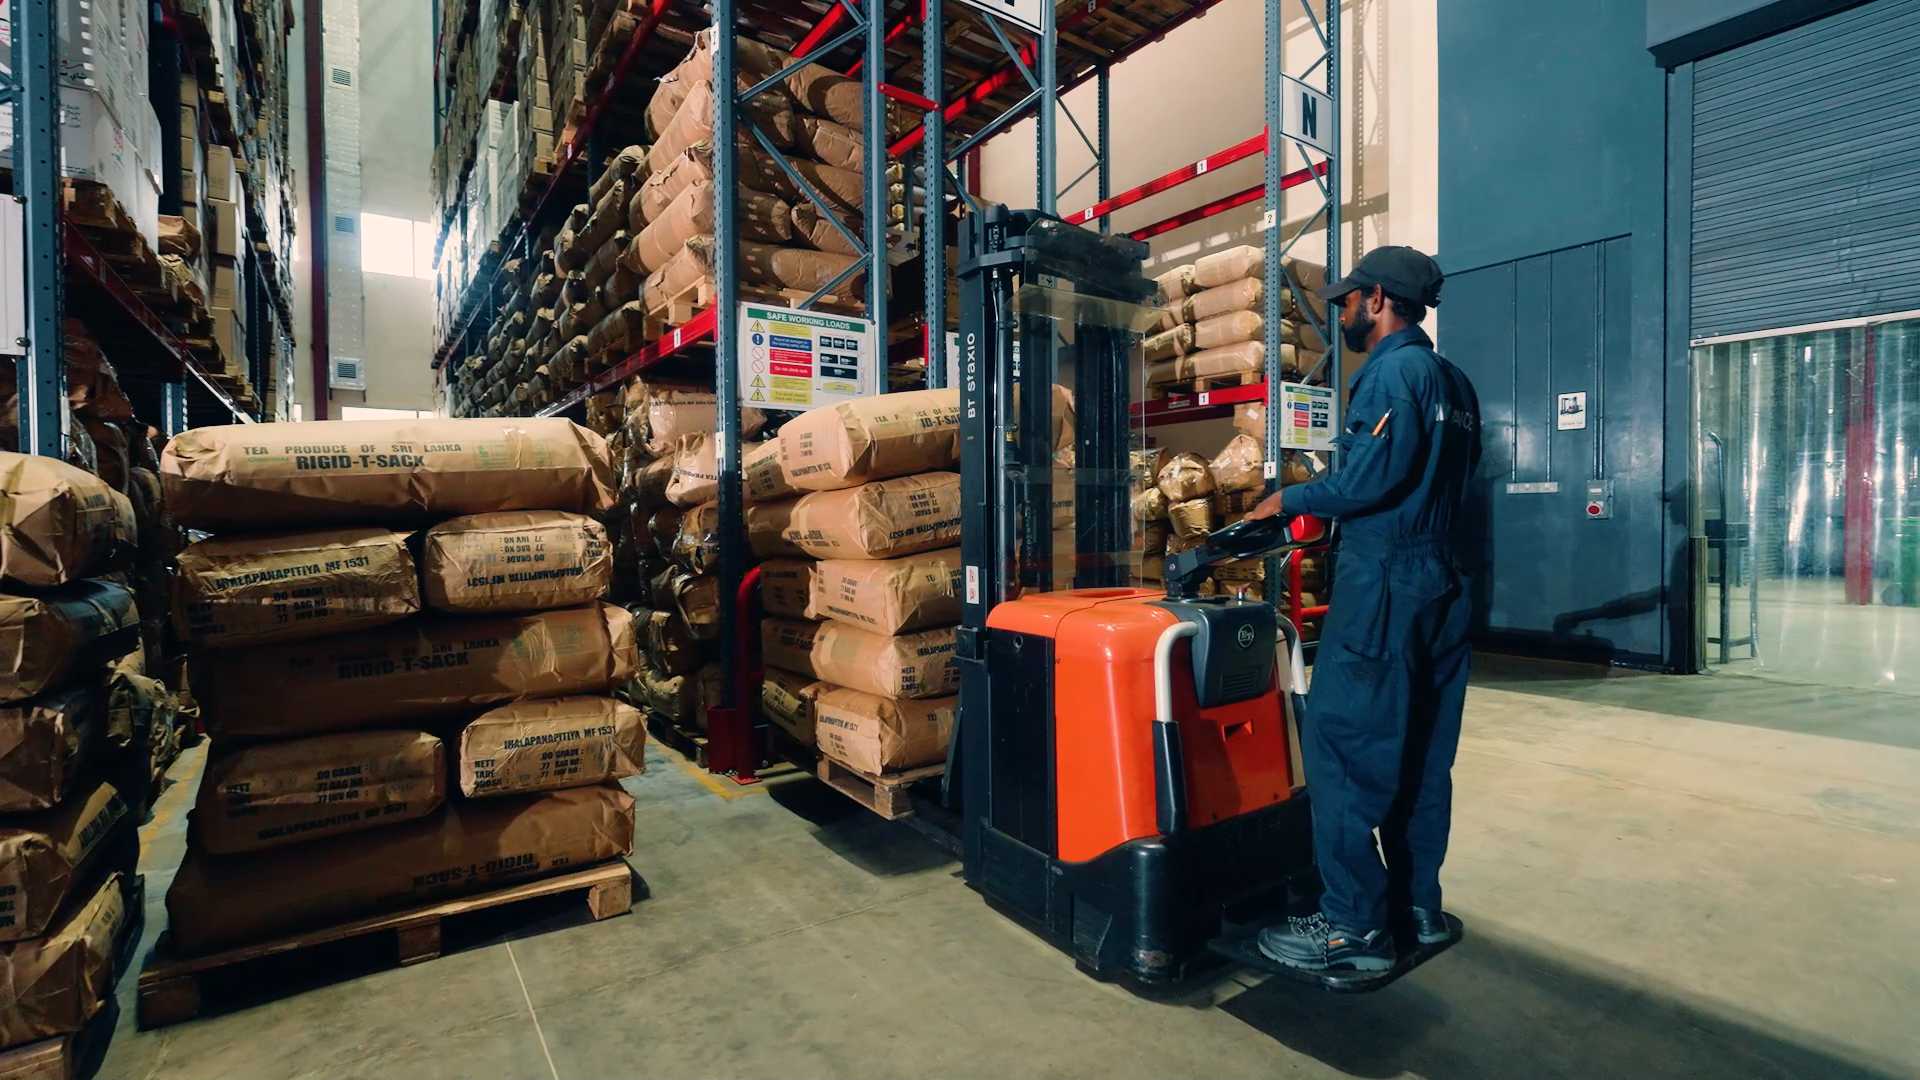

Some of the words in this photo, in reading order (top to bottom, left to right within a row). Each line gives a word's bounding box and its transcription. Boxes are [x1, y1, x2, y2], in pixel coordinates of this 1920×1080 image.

[1302, 92, 1317, 139] N
[1267, 214, 1273, 224] 2
[766, 311, 788, 322] SAFE
[788, 313, 824, 327] WORKING
[825, 320, 851, 330] LOADS
[967, 399, 976, 418] BT
[243, 446, 268, 456] TEA
[284, 445, 348, 455] PRODUCE
[360, 444, 376, 454] OF
[391, 444, 413, 453] SRI
[423, 443, 462, 453] LANKA
[296, 454, 426, 470] RIGID-T-SACK
[325, 561, 341, 572] MF
[344, 556, 370, 569] 1531
[337, 652, 470, 679] RIGID-T-SACK
[583, 728, 596, 739] MF
[598, 725, 616, 736] 1531
